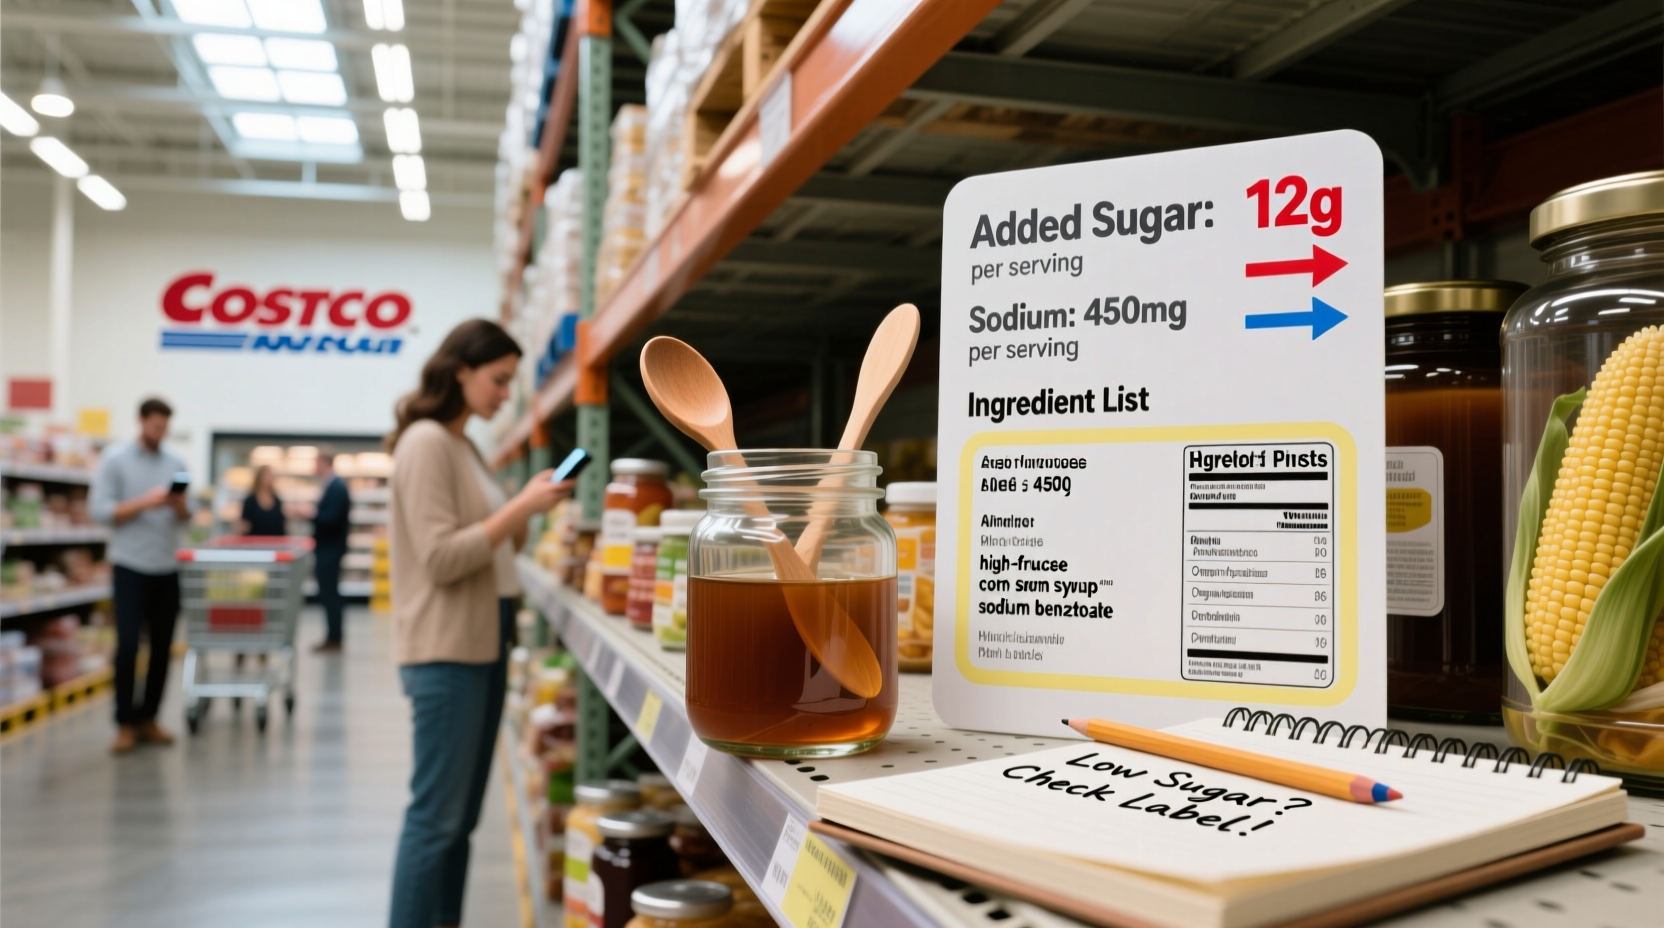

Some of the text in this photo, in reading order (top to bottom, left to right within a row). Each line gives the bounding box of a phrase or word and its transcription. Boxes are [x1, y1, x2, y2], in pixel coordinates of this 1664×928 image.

[969, 200, 1214, 249] Added Sugar:
[1246, 174, 1343, 238] 12g
[971, 253, 1083, 286] per serving
[968, 296, 1187, 333] Sodium: 450mg
[968, 337, 1079, 367] per serving
[968, 385, 1150, 424] Ingredient List
[1002, 764, 1275, 837] Check Label!
[1065, 752, 1313, 816] Low Sugar?
